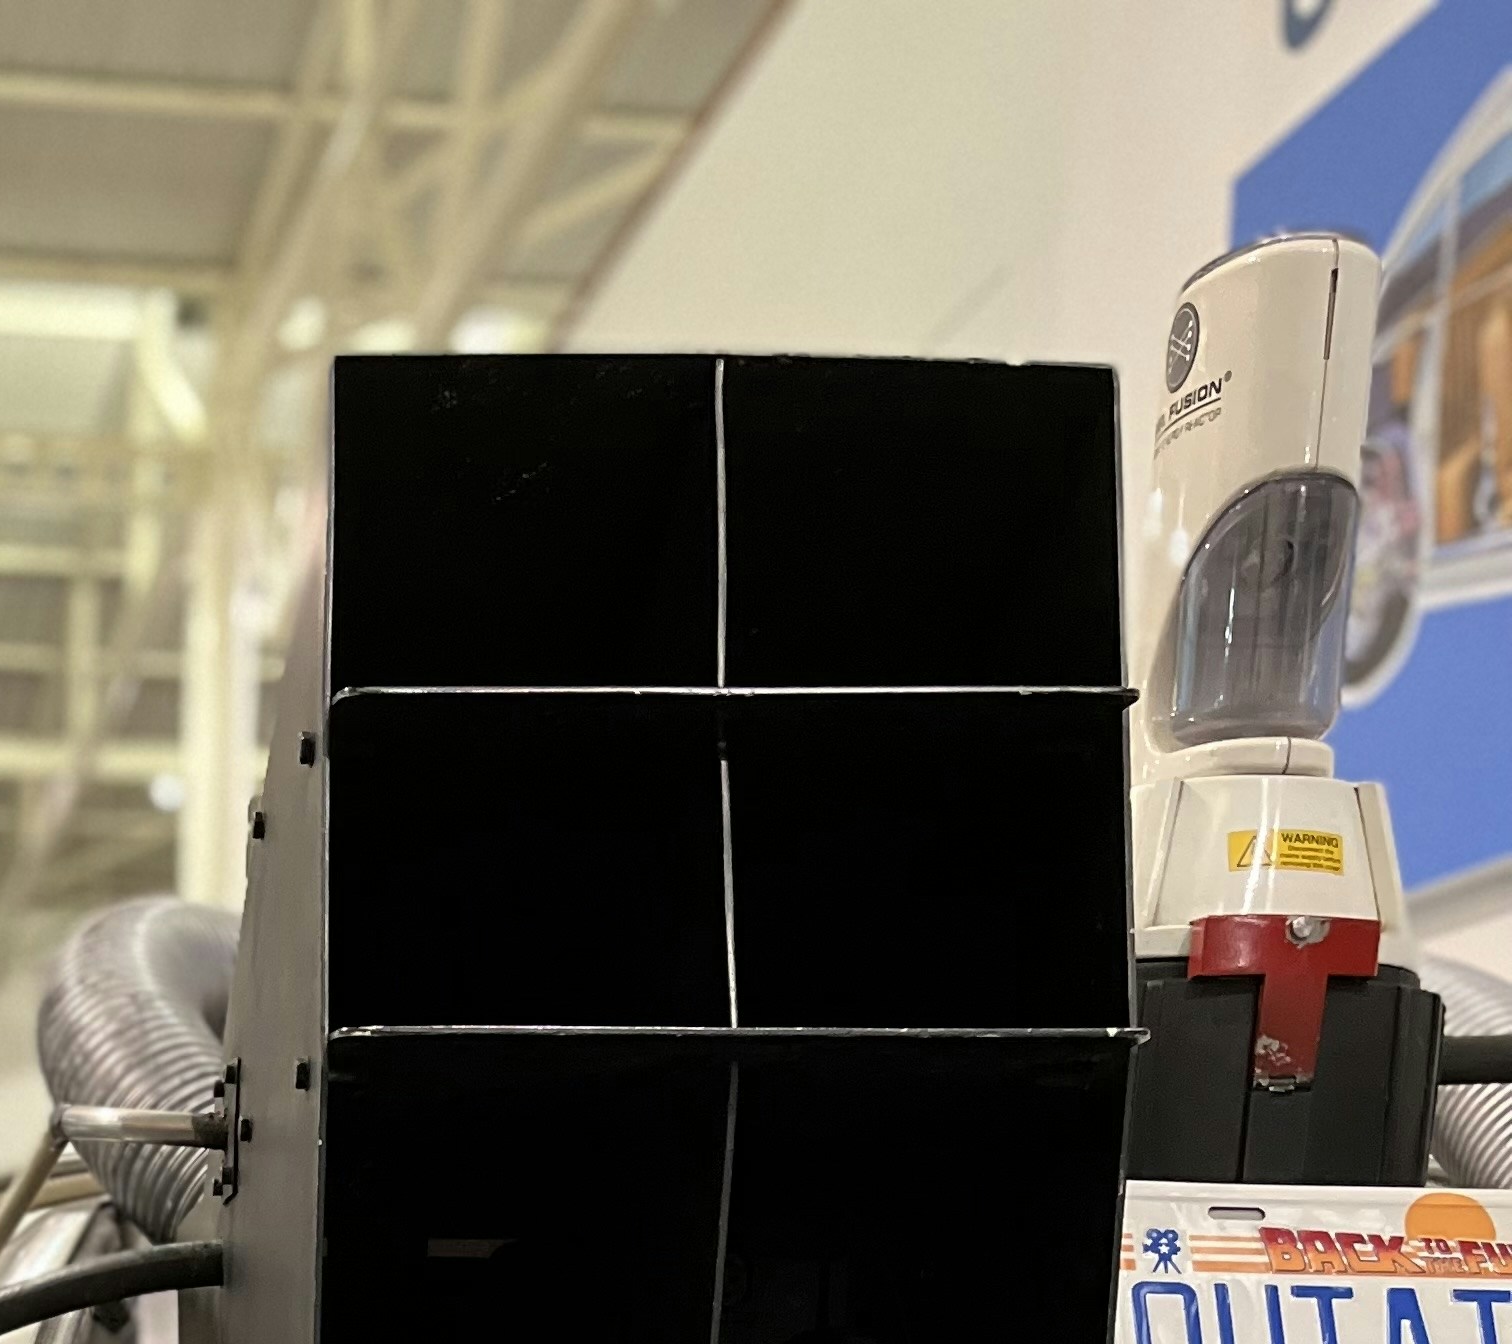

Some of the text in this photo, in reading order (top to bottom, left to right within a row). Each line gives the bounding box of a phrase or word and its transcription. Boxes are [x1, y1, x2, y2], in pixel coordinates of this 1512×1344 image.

[1168, 377, 1223, 421] FUSION
[1281, 832, 1339, 848] WARNING
[1259, 1227, 1426, 1274] BACK
[1418, 1238, 1452, 1255] TO
